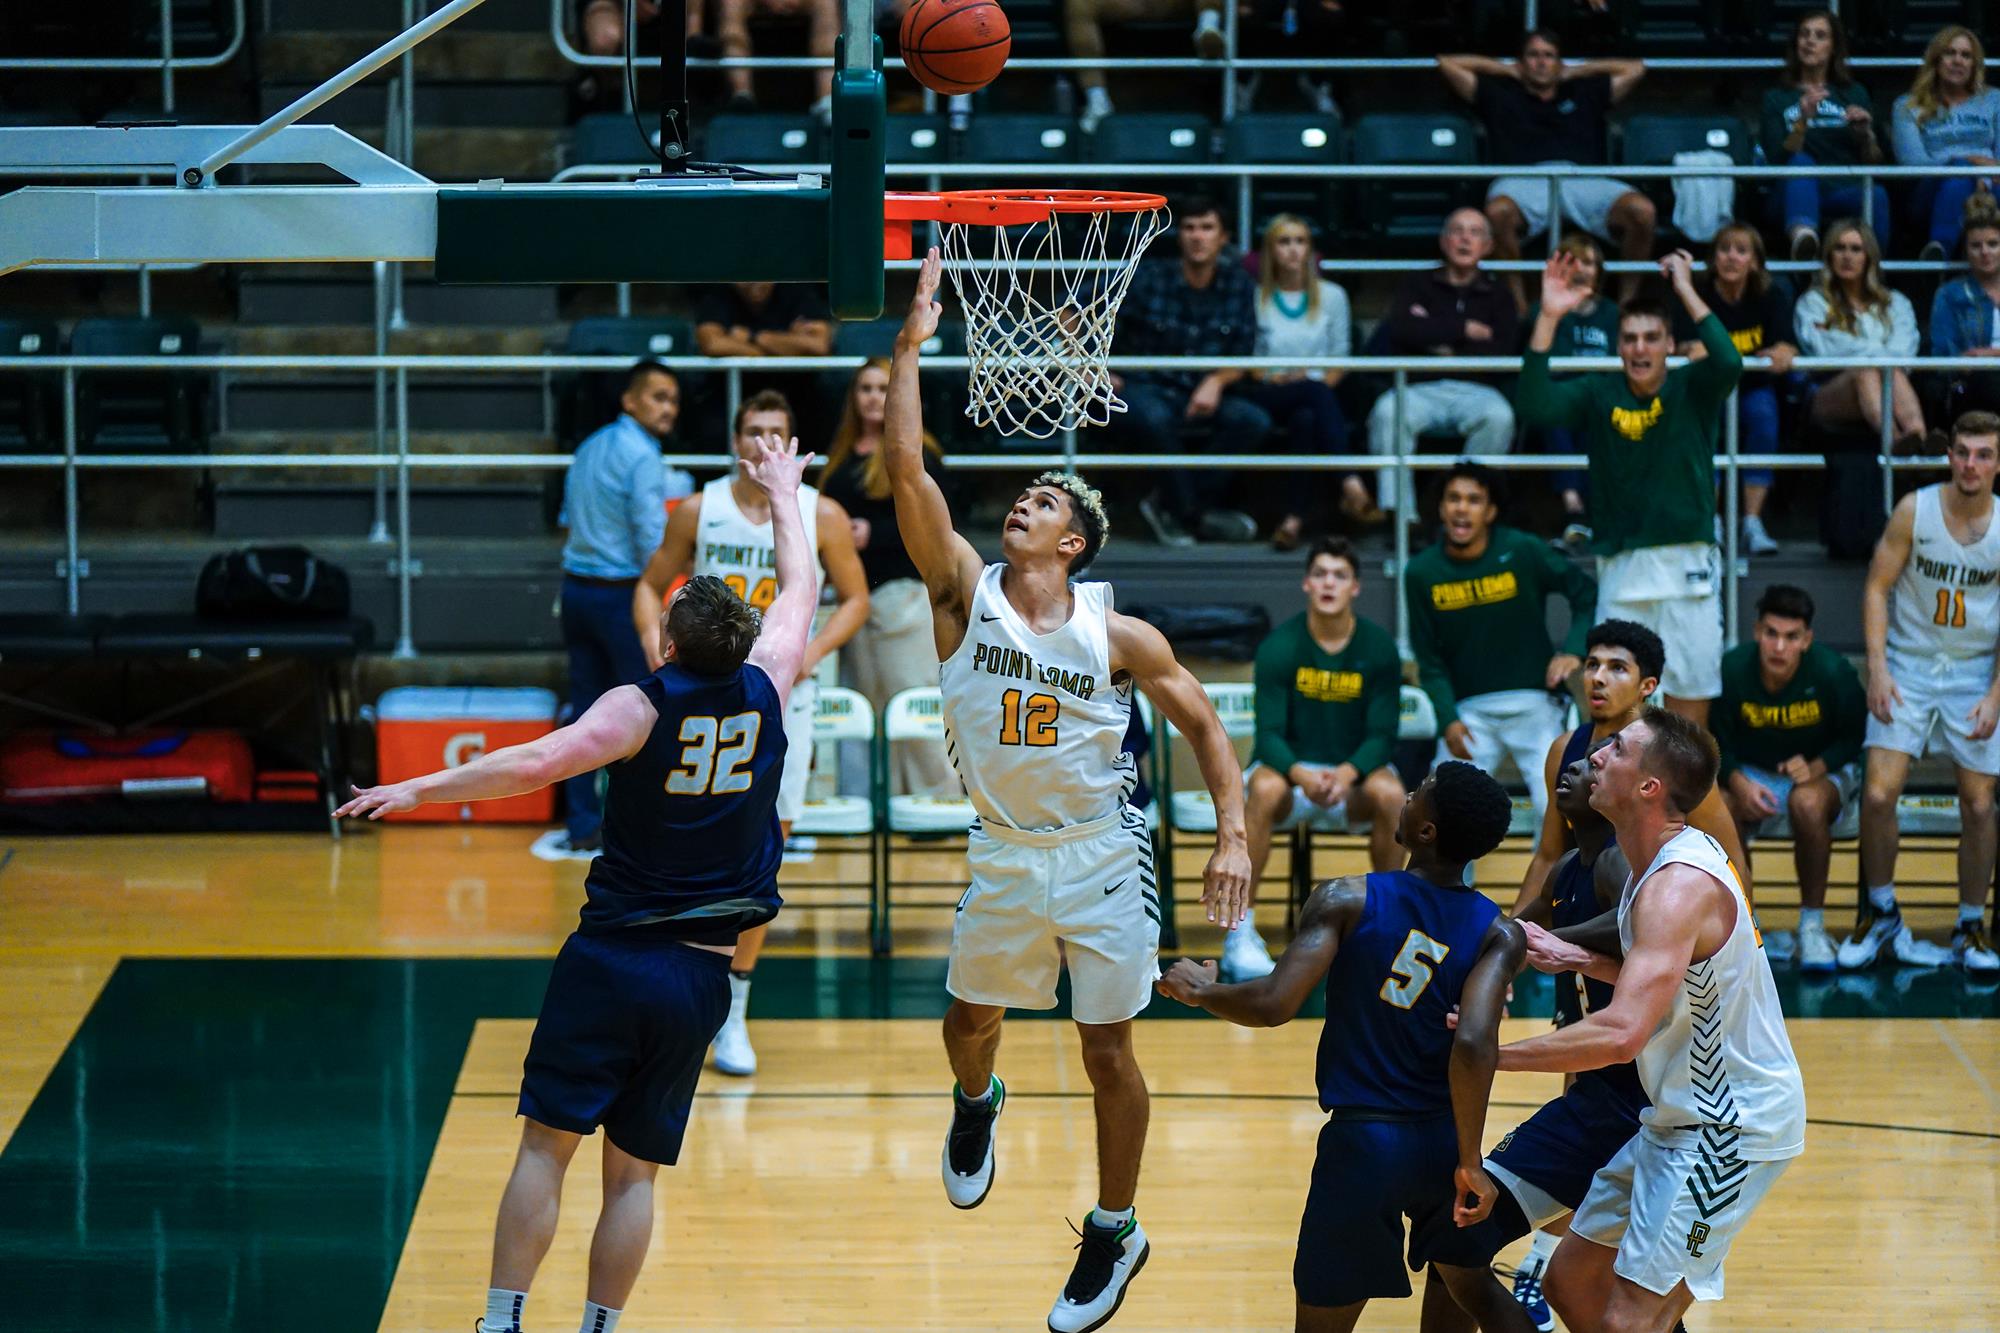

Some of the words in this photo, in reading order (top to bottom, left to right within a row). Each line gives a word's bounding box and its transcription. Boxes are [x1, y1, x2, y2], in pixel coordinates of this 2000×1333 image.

[706, 543, 753, 568] POINT
[757, 548, 776, 569] LO
[1915, 554, 1958, 584] POINT
[1933, 588, 1967, 628] 11
[974, 643, 1033, 681] POINT
[1037, 663, 1095, 701] LOMA
[999, 688, 1061, 747] 12
[664, 710, 762, 796] 32
[1379, 928, 1450, 1010] 5
